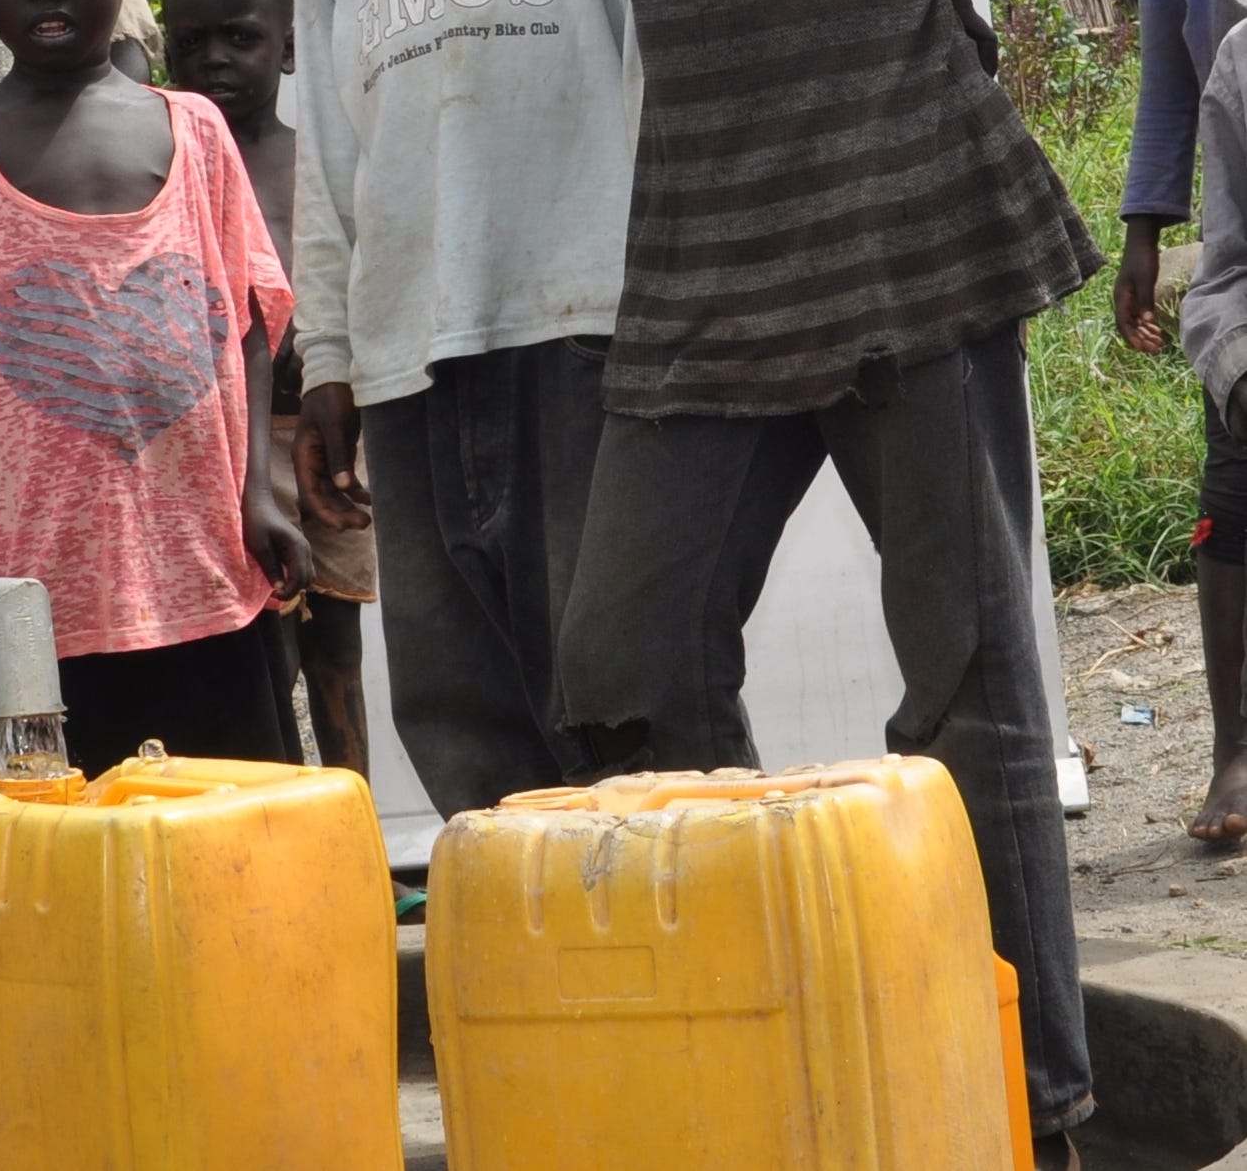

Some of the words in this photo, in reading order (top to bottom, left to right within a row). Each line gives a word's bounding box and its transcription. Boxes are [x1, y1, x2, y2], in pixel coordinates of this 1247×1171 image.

[387, 42, 432, 68] Jenkins
[495, 23, 526, 36] Bike
[530, 22, 560, 36] Club
